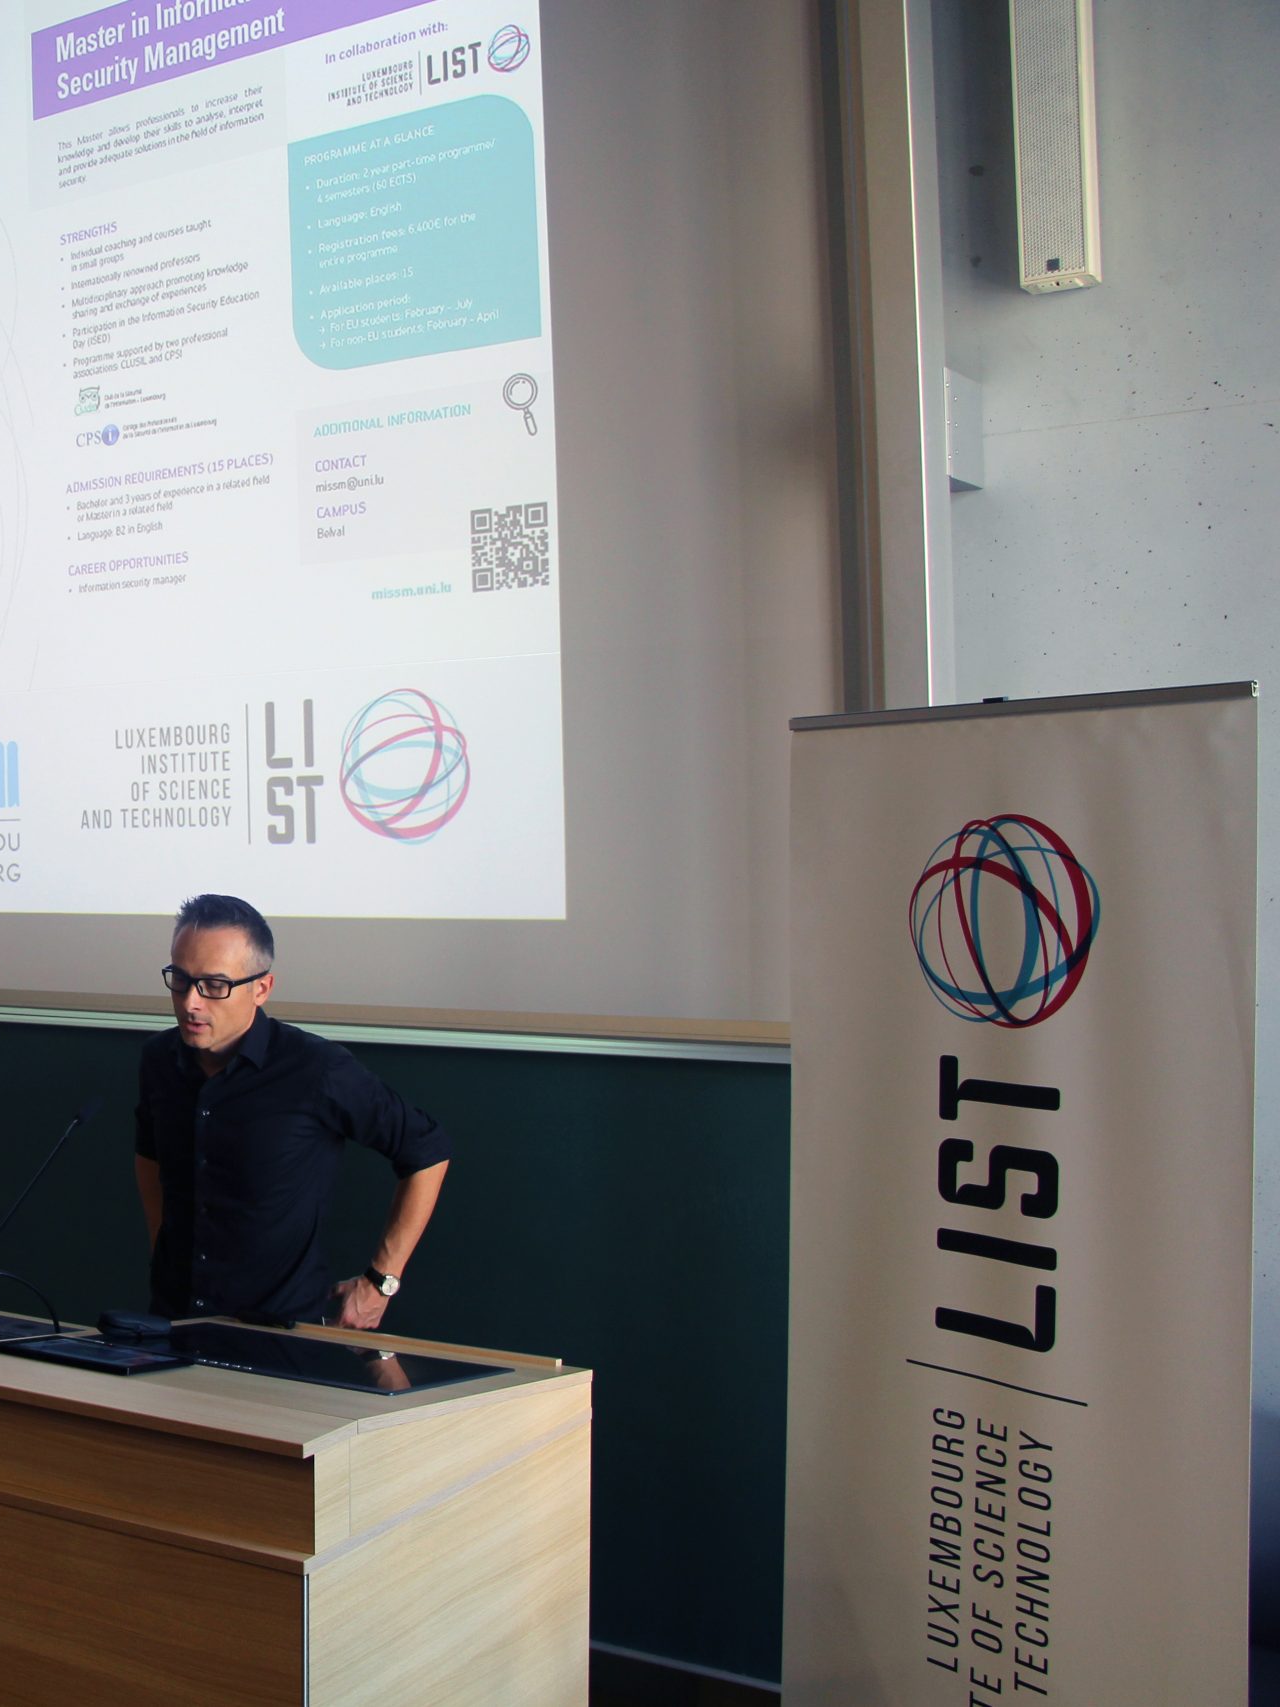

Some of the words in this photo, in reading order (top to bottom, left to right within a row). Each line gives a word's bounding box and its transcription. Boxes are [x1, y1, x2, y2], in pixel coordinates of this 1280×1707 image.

[56, 22, 125, 63] Master
[132, 12, 149, 38] in
[57, 56, 138, 99] Security
[145, 7, 285, 73] Management
[326, 54, 337, 65] In
[339, 32, 417, 61] collaboration
[419, 21, 449, 38] with:
[362, 61, 414, 82] LUXEMBOURG
[427, 42, 482, 85] LIST
[328, 84, 367, 103] INSTITUTE
[369, 81, 379, 92] OF
[381, 71, 414, 88] SCIENCE
[347, 95, 363, 107] AND
[365, 82, 414, 103] TECHNOLOGY
[58, 140, 73, 151] This
[77, 132, 104, 146] Master
[108, 125, 131, 137] allows
[136, 108, 186, 132] professionals
[191, 104, 200, 114] to
[205, 94, 239, 110] increase
[245, 86, 264, 99] their
[305, 142, 367, 167] PROGRAMME
[370, 139, 382, 151] AT
[383, 137, 392, 148] A
[394, 126, 436, 145] GLANCE
[318, 211, 369, 229] Language:
[370, 201, 402, 218] English
[60, 222, 118, 246] STRENGTHS
[71, 244, 103, 261] Individual
[105, 239, 137, 253] coaching
[139, 233, 153, 245] and
[154, 228, 185, 242] courses
[186, 219, 212, 234] taught
[71, 271, 122, 291] Internationally
[123, 262, 159, 279] renowned
[160, 255, 201, 273] professors
[73, 321, 118, 337] Participation
[119, 318, 126, 328] in
[128, 315, 140, 326] the
[142, 307, 185, 323] Information
[187, 299, 218, 314] Security
[220, 292, 260, 307] Education
[74, 353, 115, 368] Programme
[117, 342, 153, 360] supported
[155, 341, 164, 353] by
[166, 339, 180, 349] two
[182, 327, 229, 348] professional
[314, 416, 385, 438] ADDITIONAL
[388, 404, 472, 428] INFORMATION
[67, 476, 122, 494] ADMISSION
[125, 464, 206, 486] REQUIREMENTS
[207, 461, 225, 475] (15
[227, 453, 275, 471] PLACES)
[316, 456, 367, 473] CONTACT
[77, 499, 108, 511] Bachelor
[109, 496, 124, 507] and
[126, 495, 130, 505] 3
[131, 494, 152, 506] years
[153, 491, 162, 501] of
[163, 487, 205, 501] experience
[207, 484, 214, 493] in
[223, 478, 251, 491] related
[253, 475, 271, 487] field
[316, 474, 384, 494] missm@uni.lu
[316, 502, 366, 519] CAMPUS
[317, 526, 345, 540] Belval
[69, 561, 107, 577] CAREER
[109, 552, 189, 572] OPPORTUNITIES
[79, 581, 121, 594] Information
[122, 577, 151, 589] security
[153, 575, 187, 586] manager
[371, 582, 451, 600] missm.uni.lu
[115, 724, 231, 750] LUXEMBOURG
[141, 751, 231, 775] INSTITUTE
[131, 781, 151, 802] OF
[158, 777, 231, 801] SCIENCE
[81, 807, 113, 830] AND
[120, 806, 232, 829] TECHNOLOGY
[934, 1054, 1061, 1353] LIST
[971, 1417, 1008, 1589] SCIENCE
[926, 1407, 965, 1673] LUXEMBOURG
[1014, 1431, 1054, 1696] TECHNOLOGY
[971, 1602, 1003, 1654] OF
